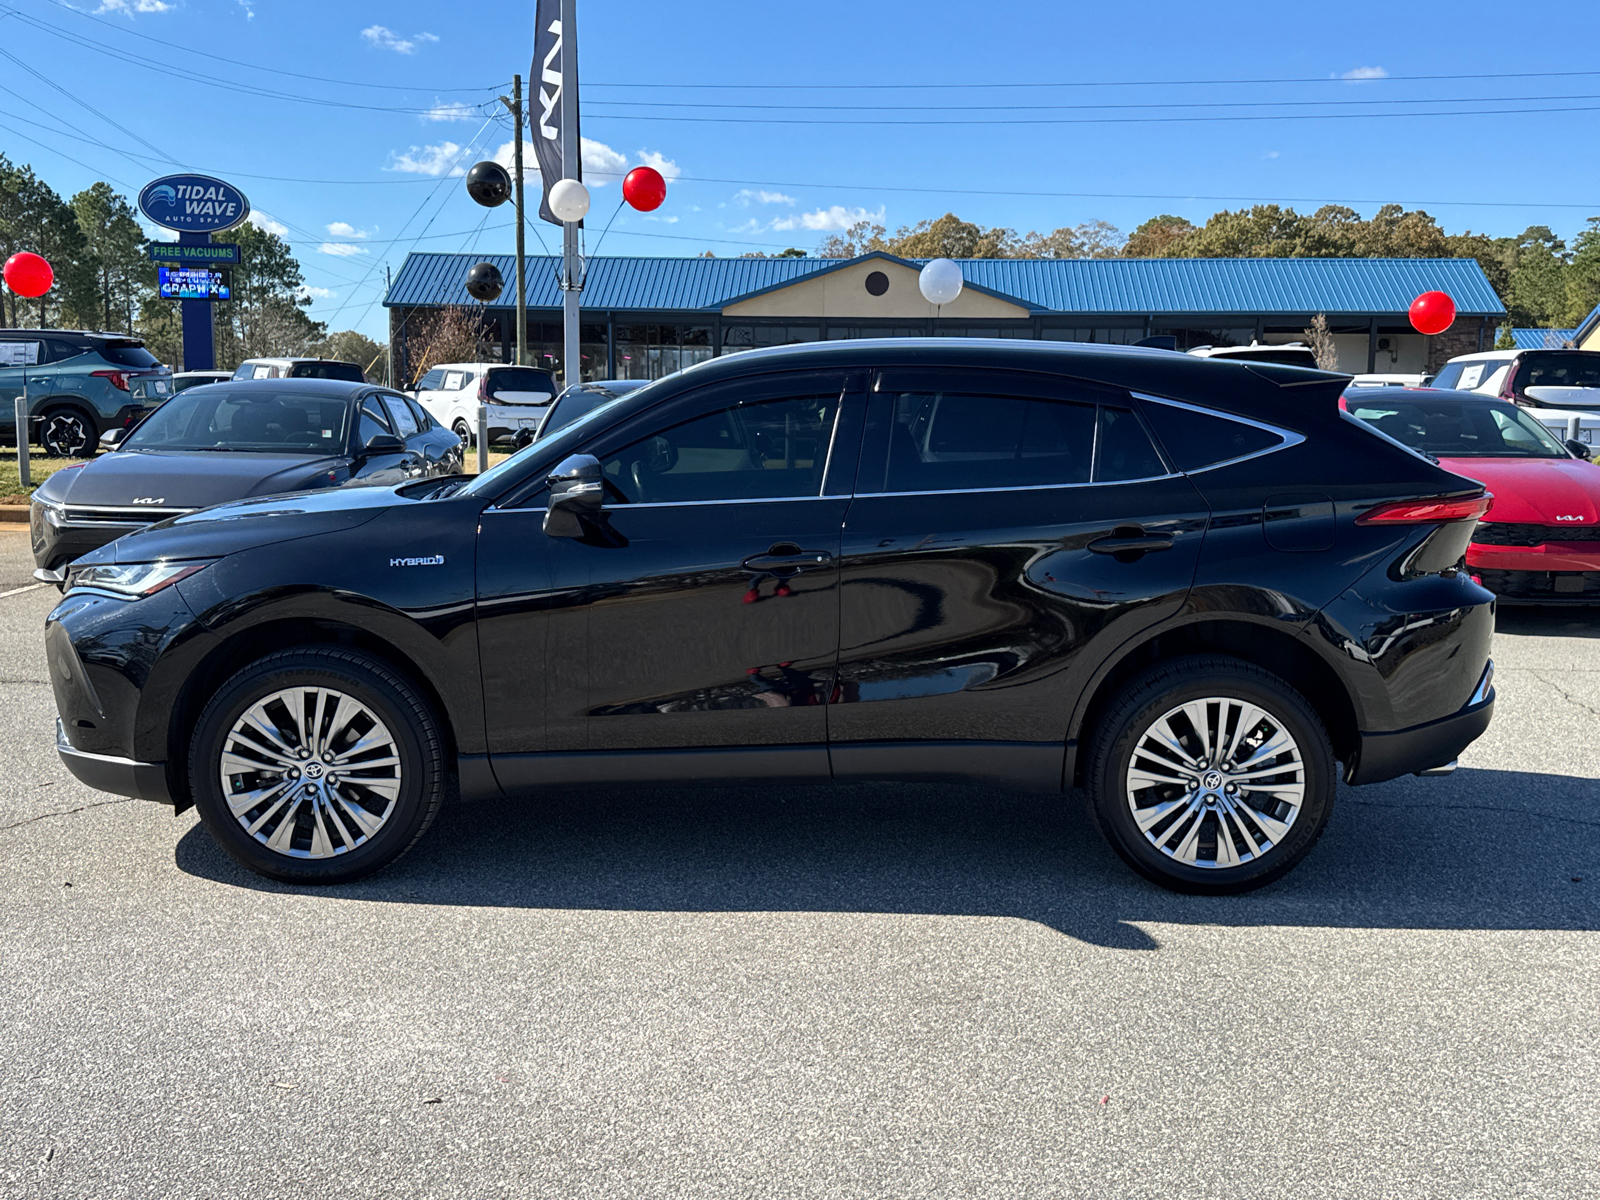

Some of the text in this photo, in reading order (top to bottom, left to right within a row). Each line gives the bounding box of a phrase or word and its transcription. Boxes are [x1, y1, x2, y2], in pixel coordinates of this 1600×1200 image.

[177, 185, 226, 200] TIDAL
[185, 200, 236, 216] WAVE
[153, 246, 234, 258] FREE VACUUMS
[390, 556, 439, 566] HYBRID
[273, 668, 361, 688] YOKOHAMA
